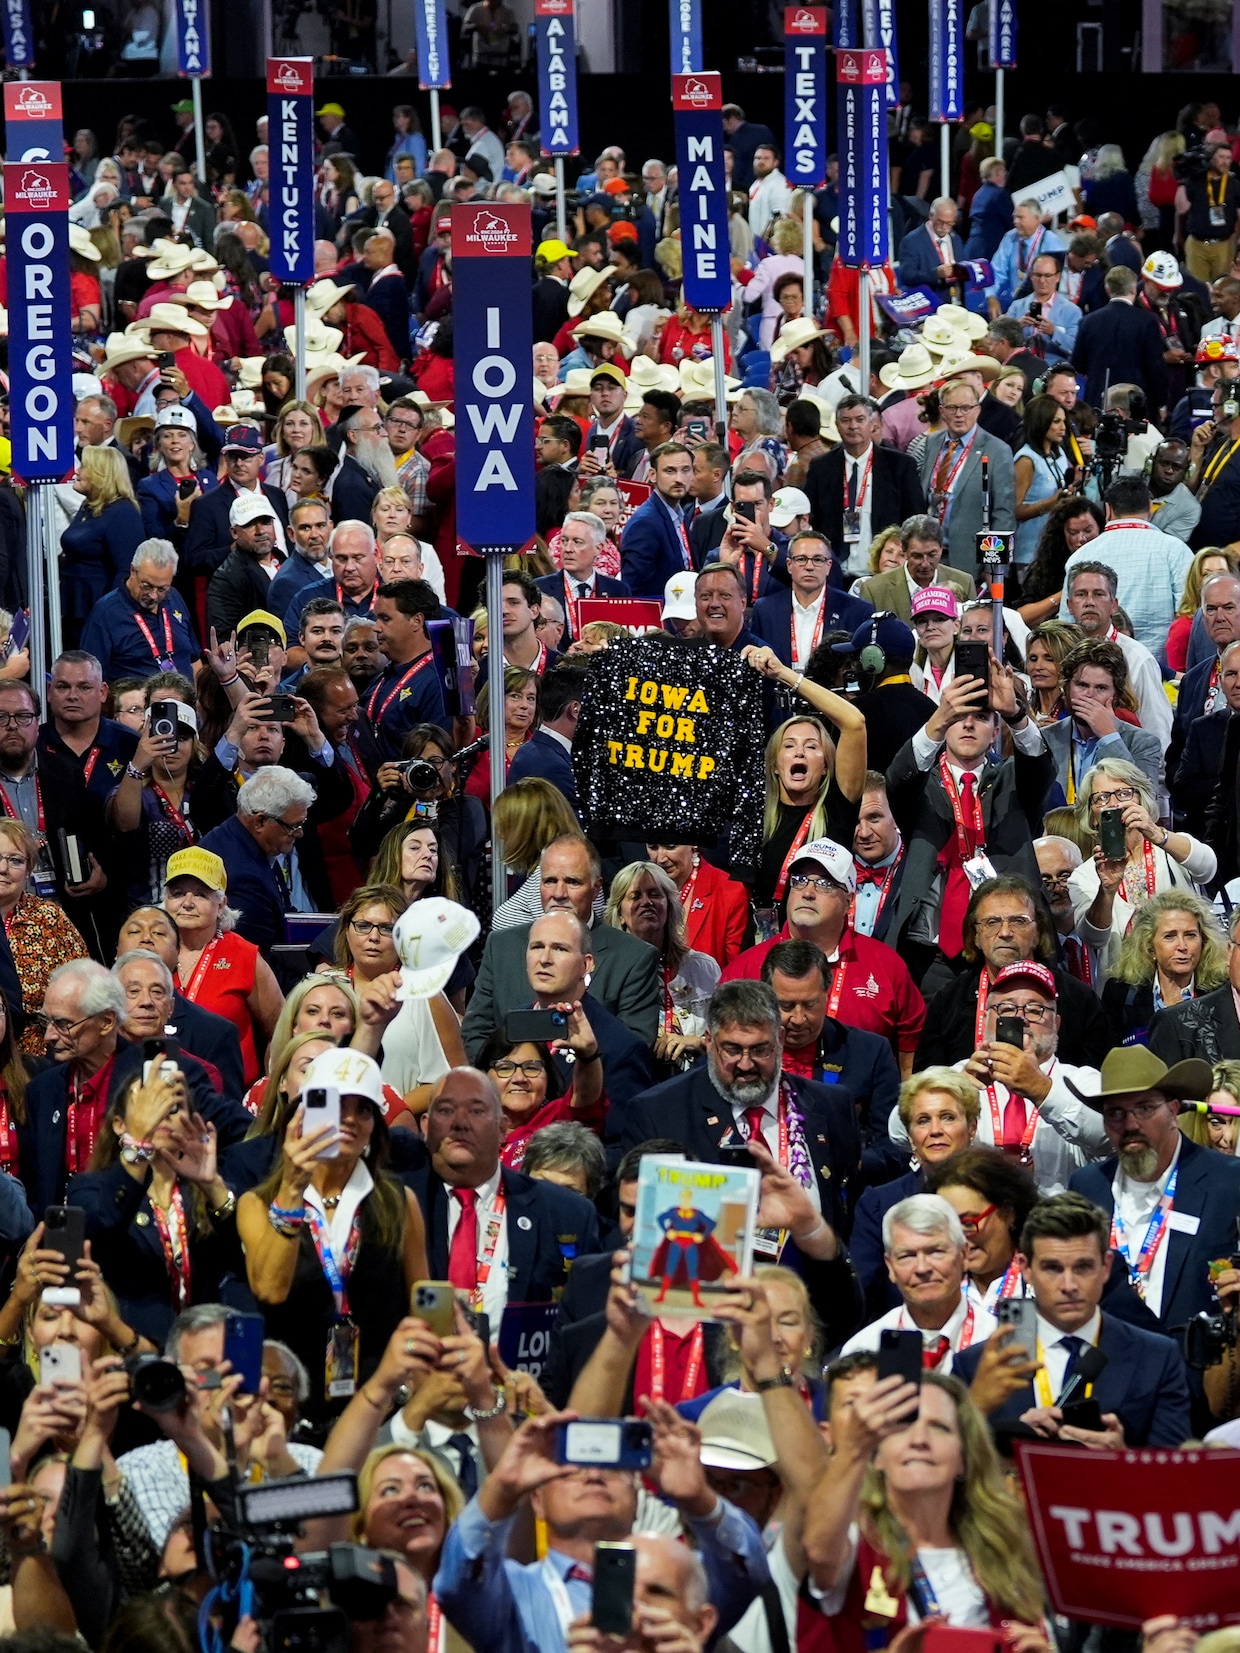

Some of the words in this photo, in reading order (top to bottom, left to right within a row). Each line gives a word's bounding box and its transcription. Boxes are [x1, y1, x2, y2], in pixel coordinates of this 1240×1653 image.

[680, 0, 692, 32] ODE
[947, 0, 958, 113] CALIFORNIA
[546, 18, 570, 146] ALABAMA
[793, 47, 818, 173] TEXAS
[846, 88, 856, 188] AMERICAN
[871, 88, 880, 188] AMERICAN
[15, 191, 58, 199] MILWAUKEE
[281, 100, 301, 272] KENTUCKY
[687, 136, 717, 279] MAINE
[847, 194, 857, 257] SAMOA
[872, 194, 882, 257] SAMOA
[466, 234, 518, 242] MILWAUKEE
[21, 222, 58, 462] OREGON
[465, 306, 524, 492] IOWA
[927, 590, 951, 602] AMERICA
[931, 599, 948, 608] AGAIN
[625, 676, 710, 713] IOWA
[636, 710, 696, 742] FOR
[607, 740, 716, 780] TRUMP
[810, 843, 837, 852] TRUMP
[400, 934, 422, 967] 47
[334, 1055, 370, 1083] 47
[656, 1167, 727, 1188] TRUMP
[1143, 1220, 1158, 1249] TRUMP
[1115, 1557, 1184, 1572] AMERICA
[1185, 1555, 1239, 1571] GREAT
